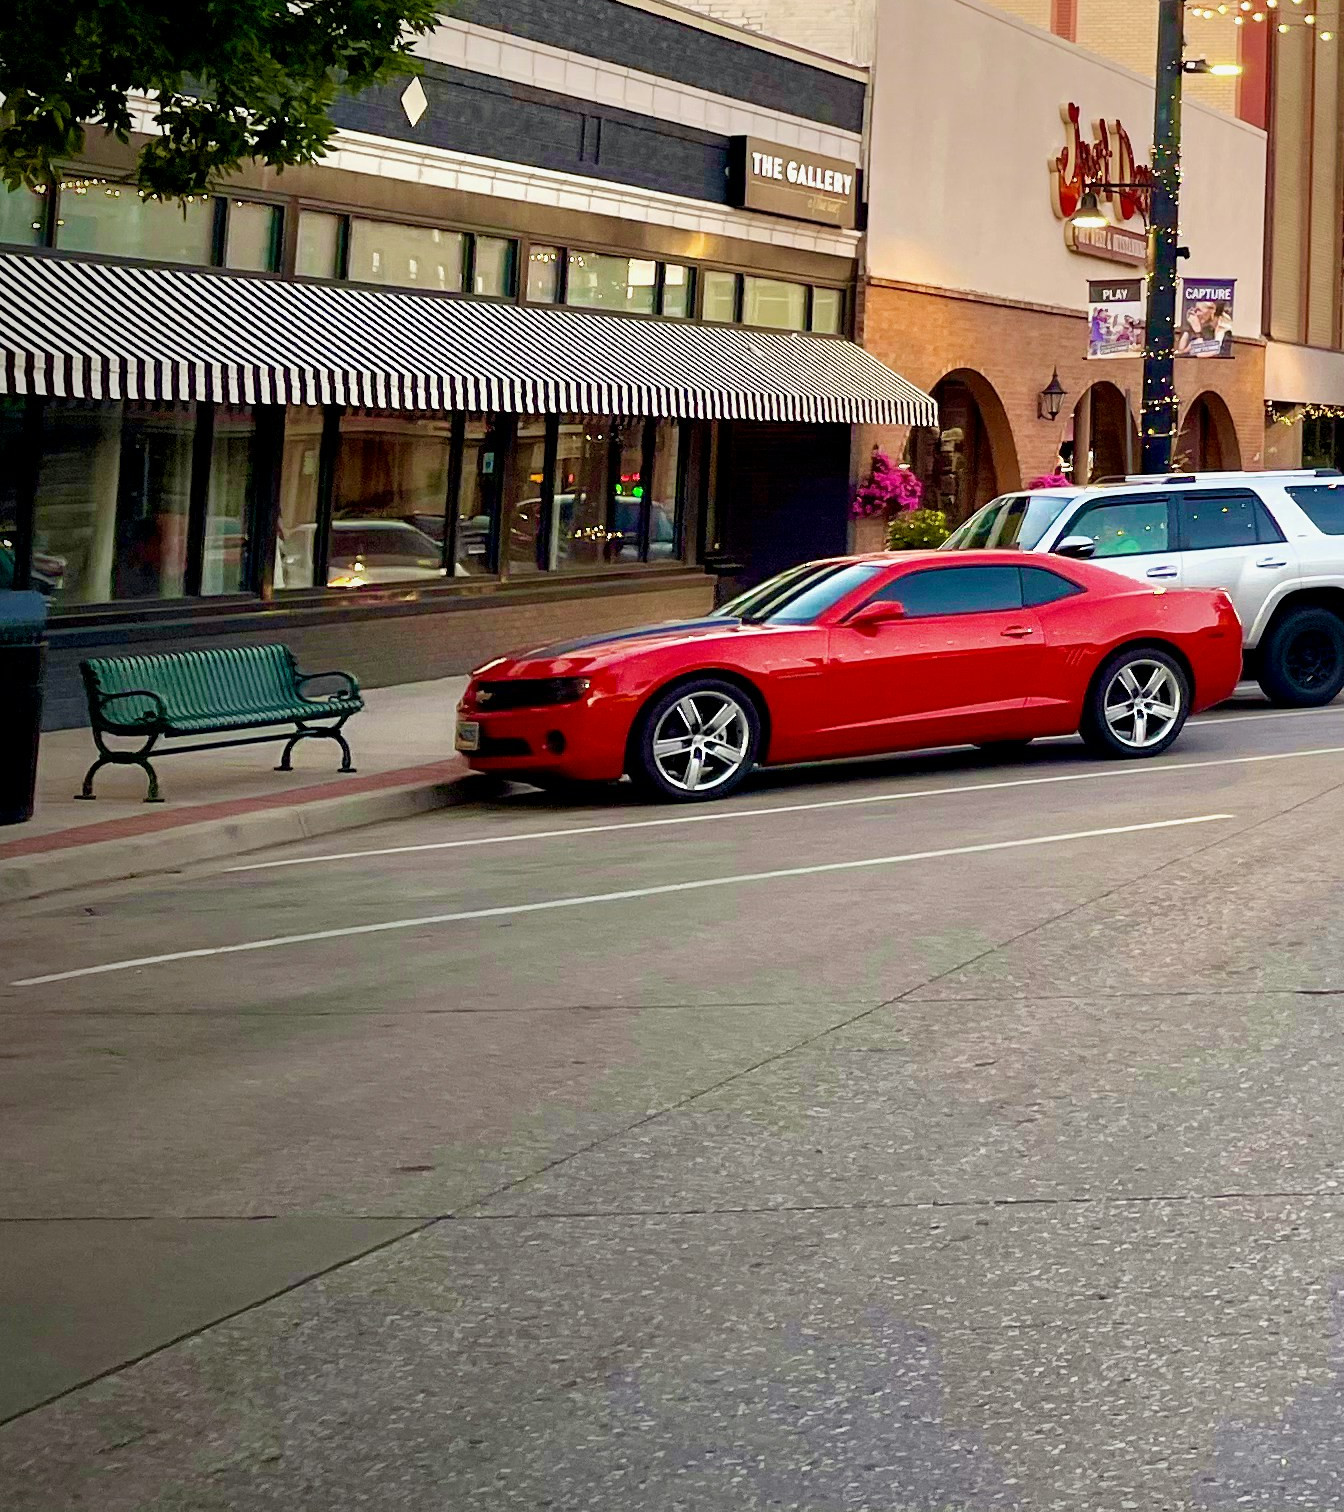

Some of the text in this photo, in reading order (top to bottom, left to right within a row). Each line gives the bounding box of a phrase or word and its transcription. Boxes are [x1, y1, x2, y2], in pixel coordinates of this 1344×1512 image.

[752, 151, 853, 196] THE GALLERY
[1102, 288, 1128, 300] PLAY
[1185, 288, 1231, 300] CAPTURE
